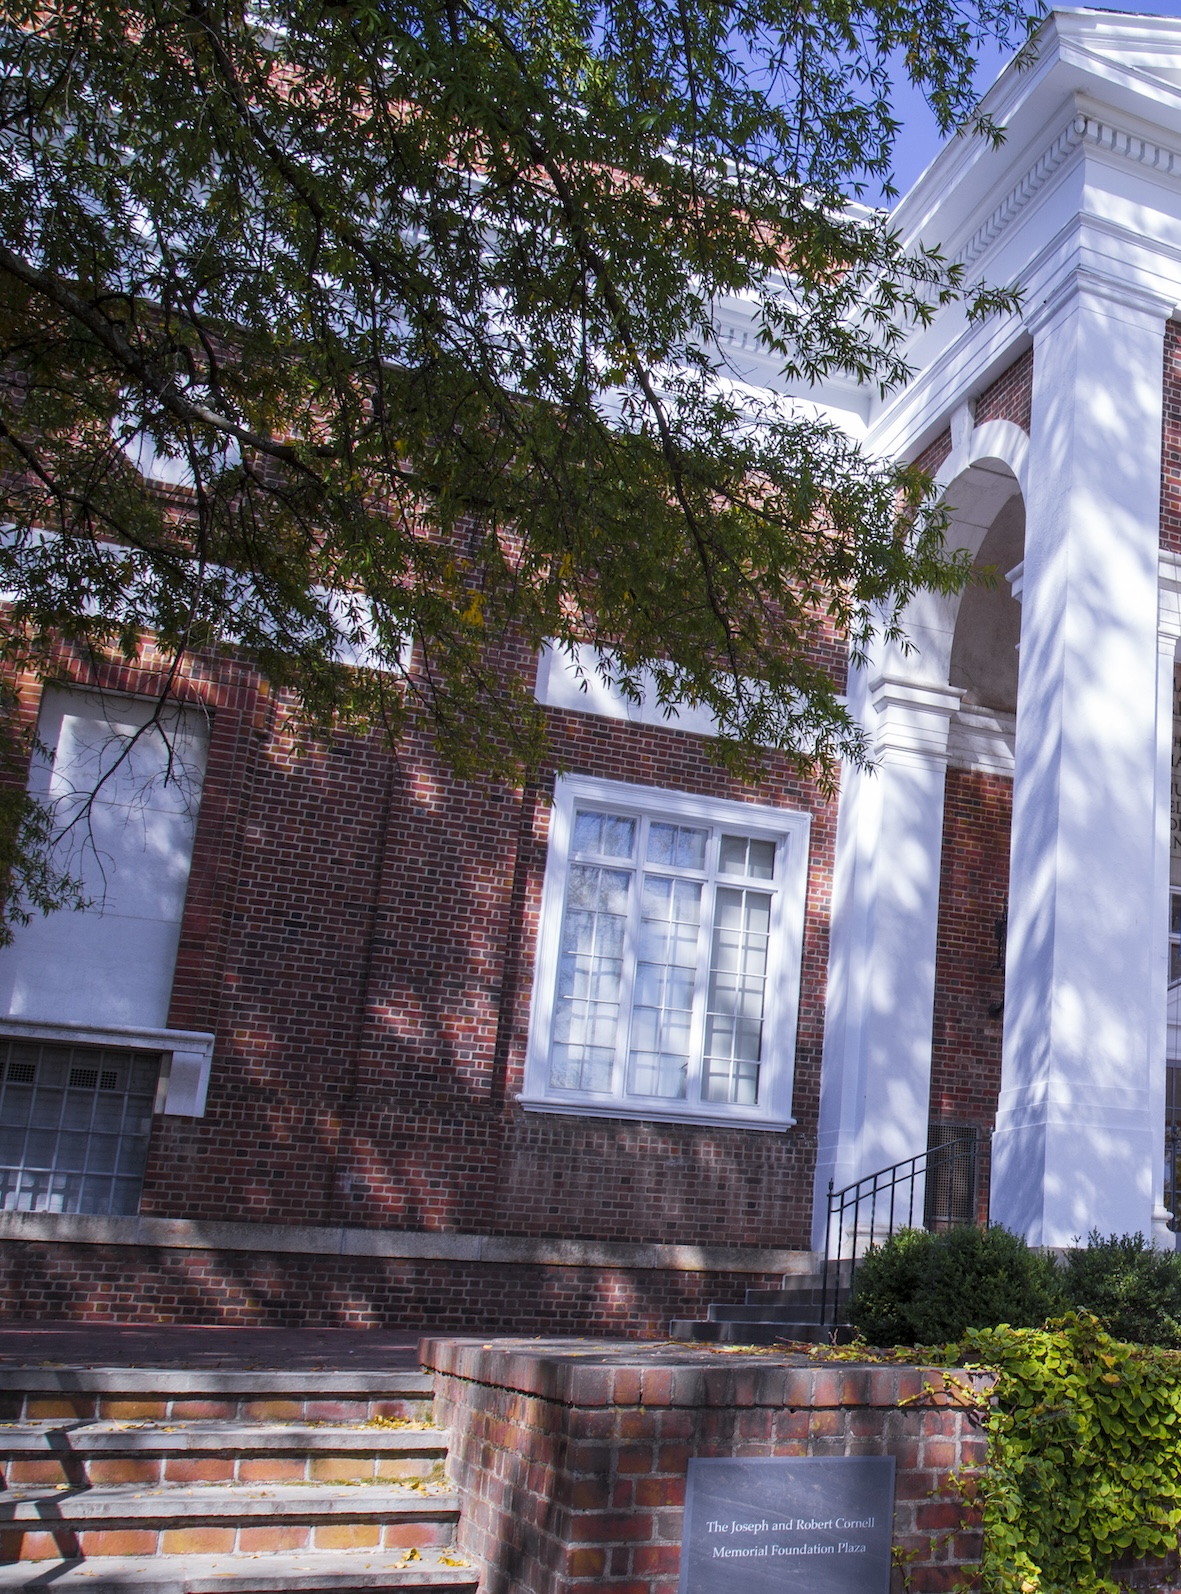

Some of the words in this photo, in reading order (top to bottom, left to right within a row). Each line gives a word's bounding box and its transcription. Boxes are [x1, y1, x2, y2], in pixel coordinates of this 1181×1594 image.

[706, 1520, 729, 1533] The
[730, 1519, 769, 1535] Joseph
[772, 1518, 793, 1531] and
[796, 1518, 833, 1530] Robert
[835, 1517, 875, 1529] Cornell
[712, 1545, 768, 1558] Memorial
[771, 1543, 835, 1556] Foundation
[837, 1542, 866, 1554] Plaza
